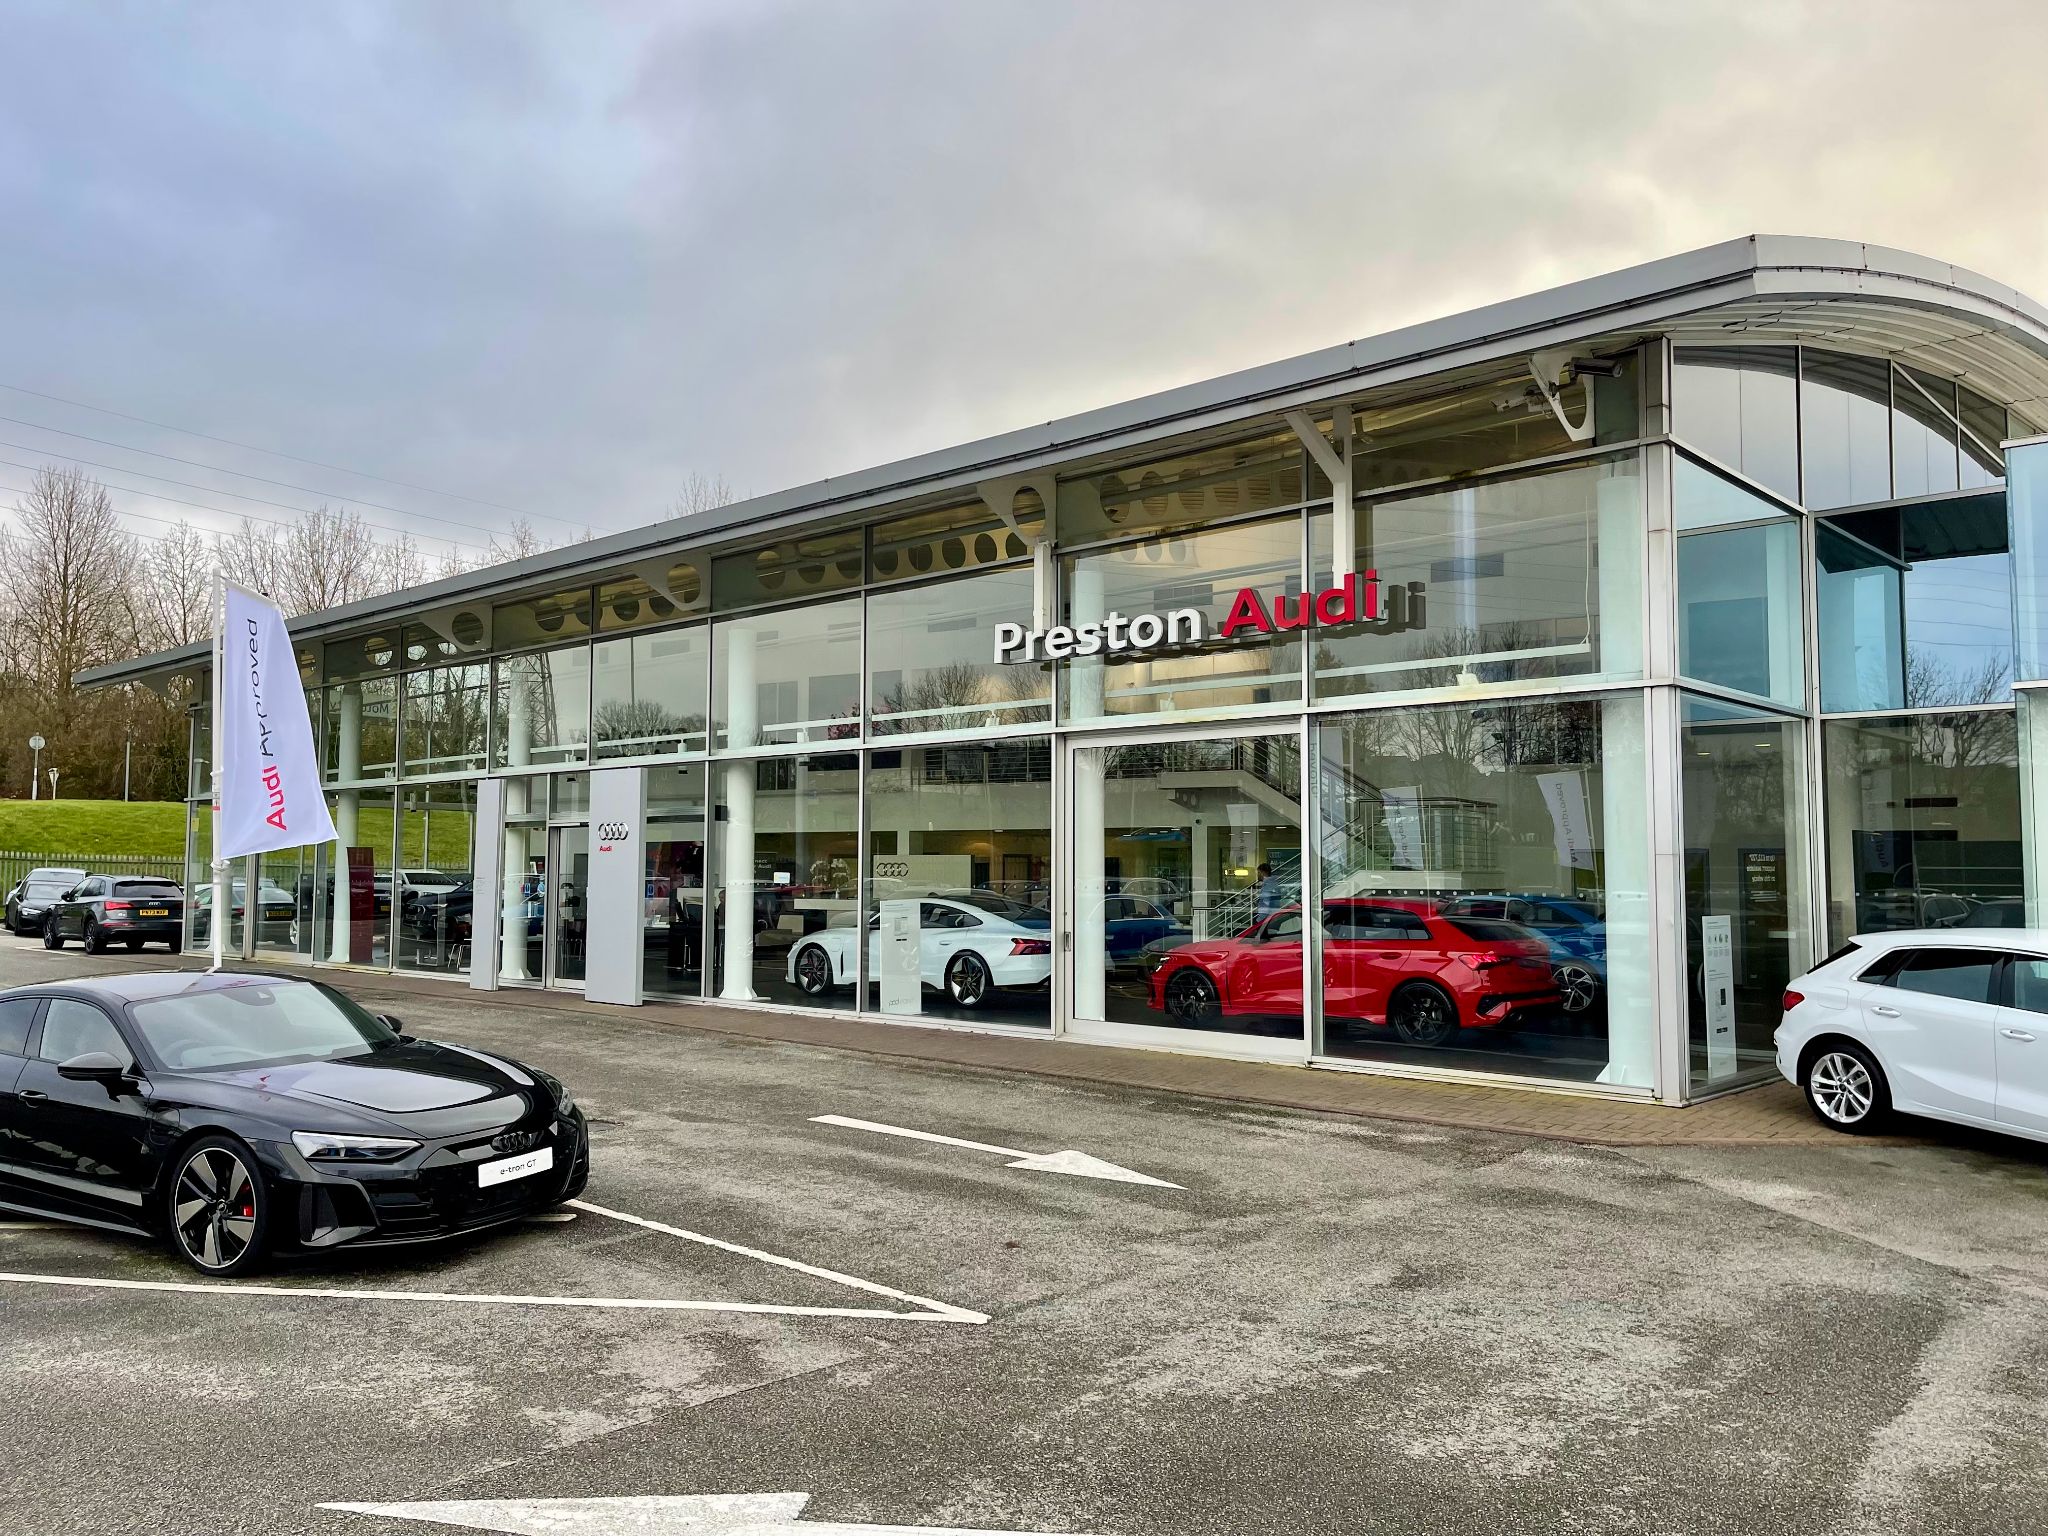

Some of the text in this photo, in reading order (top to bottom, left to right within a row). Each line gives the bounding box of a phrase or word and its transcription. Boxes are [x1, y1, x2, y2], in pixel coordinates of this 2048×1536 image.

[993, 569, 1383, 665] Preston Audi
[247, 618, 287, 831] Audi Approved
[500, 1159, 536, 1174] e-tron GT
